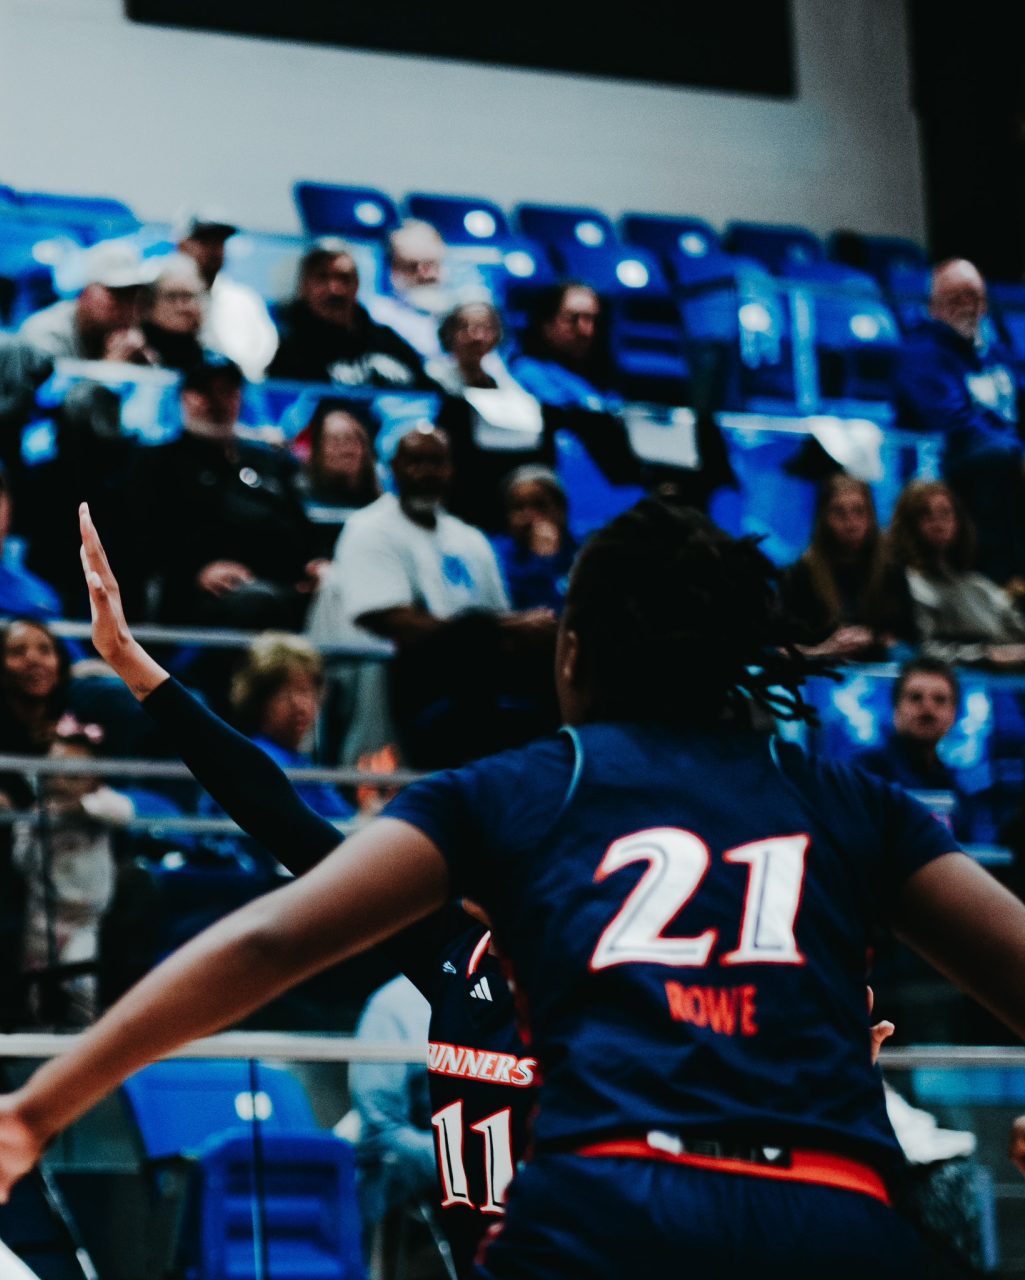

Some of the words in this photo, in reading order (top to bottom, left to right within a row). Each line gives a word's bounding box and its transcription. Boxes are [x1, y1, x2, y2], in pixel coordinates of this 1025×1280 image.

[589, 825, 811, 973] 21
[665, 980, 758, 1036] ROWE
[427, 1041, 537, 1087] UNNERS
[431, 1098, 514, 1216] 11
